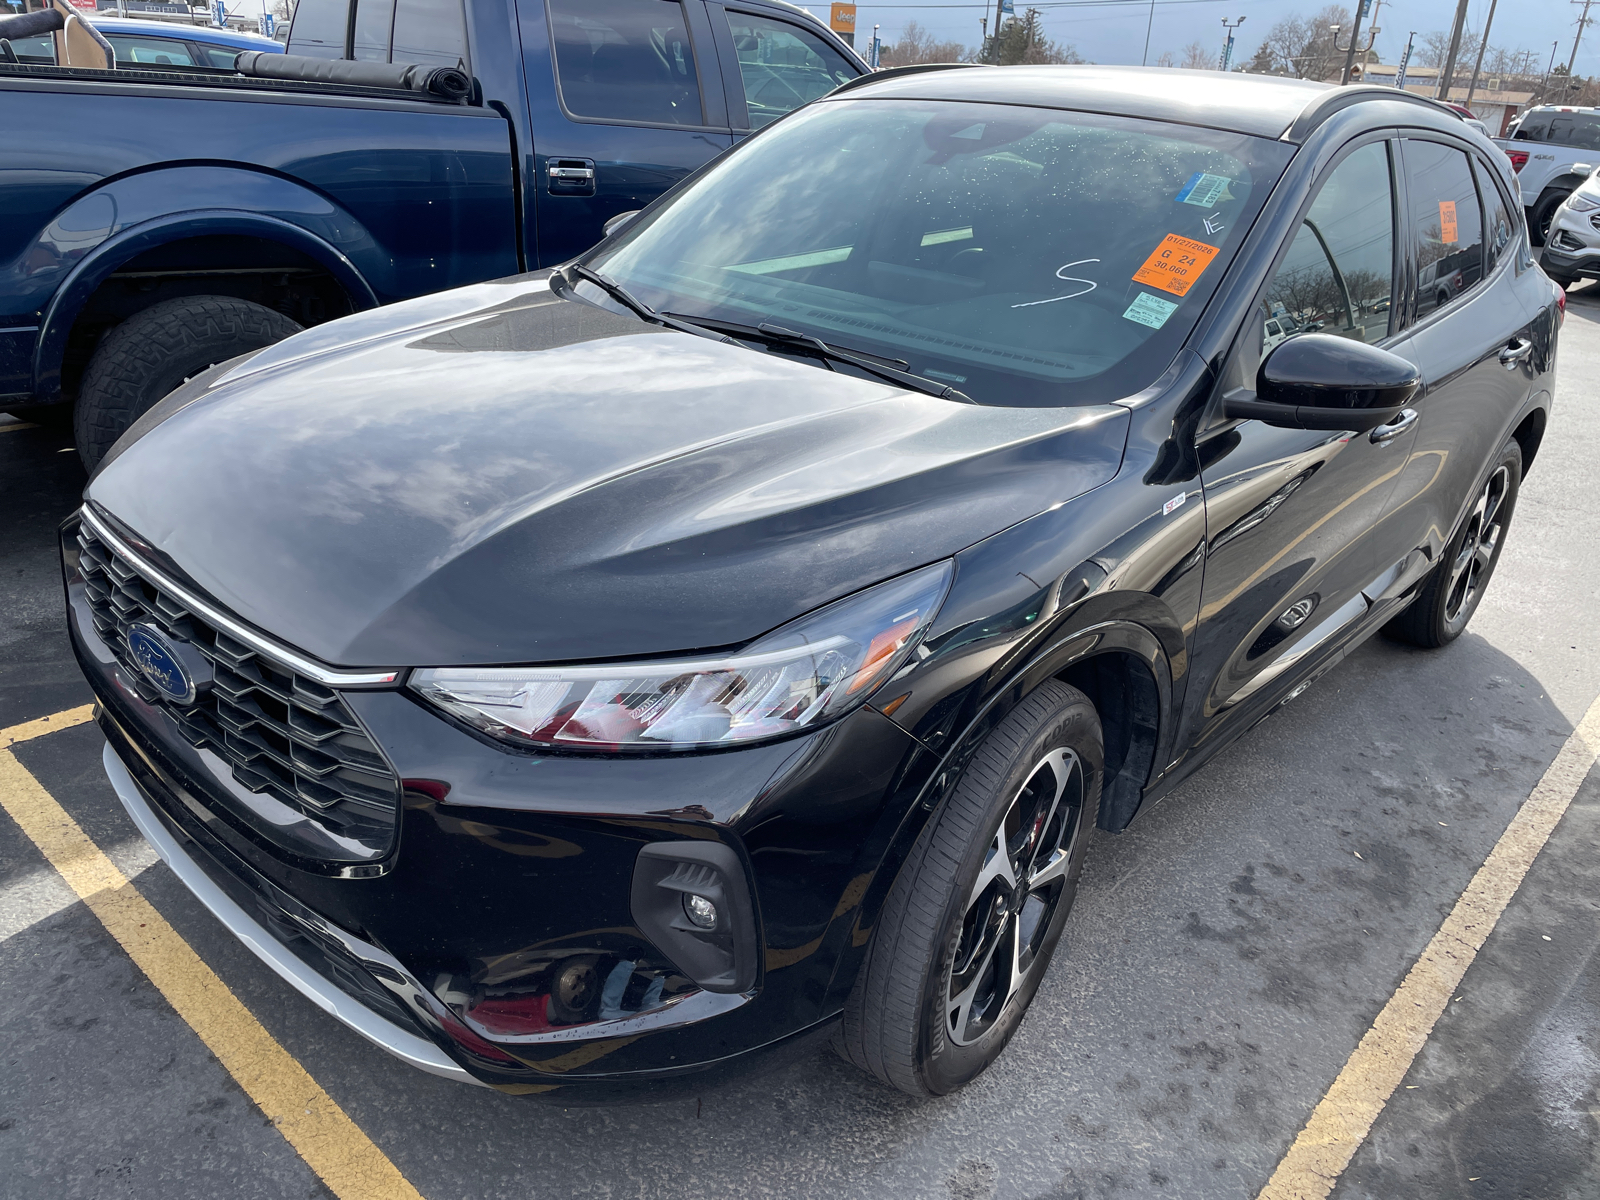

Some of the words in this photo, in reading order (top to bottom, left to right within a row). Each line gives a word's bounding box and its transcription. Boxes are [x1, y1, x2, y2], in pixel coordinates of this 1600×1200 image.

[836, 10, 855, 24] Jeep
[1166, 235, 1214, 255] 01/27/2026
[1154, 260, 1188, 276] 30,060
[1161, 249, 1173, 259] G
[1178, 255, 1197, 267] 24
[1010, 258, 1101, 309] S
[137, 639, 173, 690] Ford
[1031, 713, 1083, 765] ECOPIA
